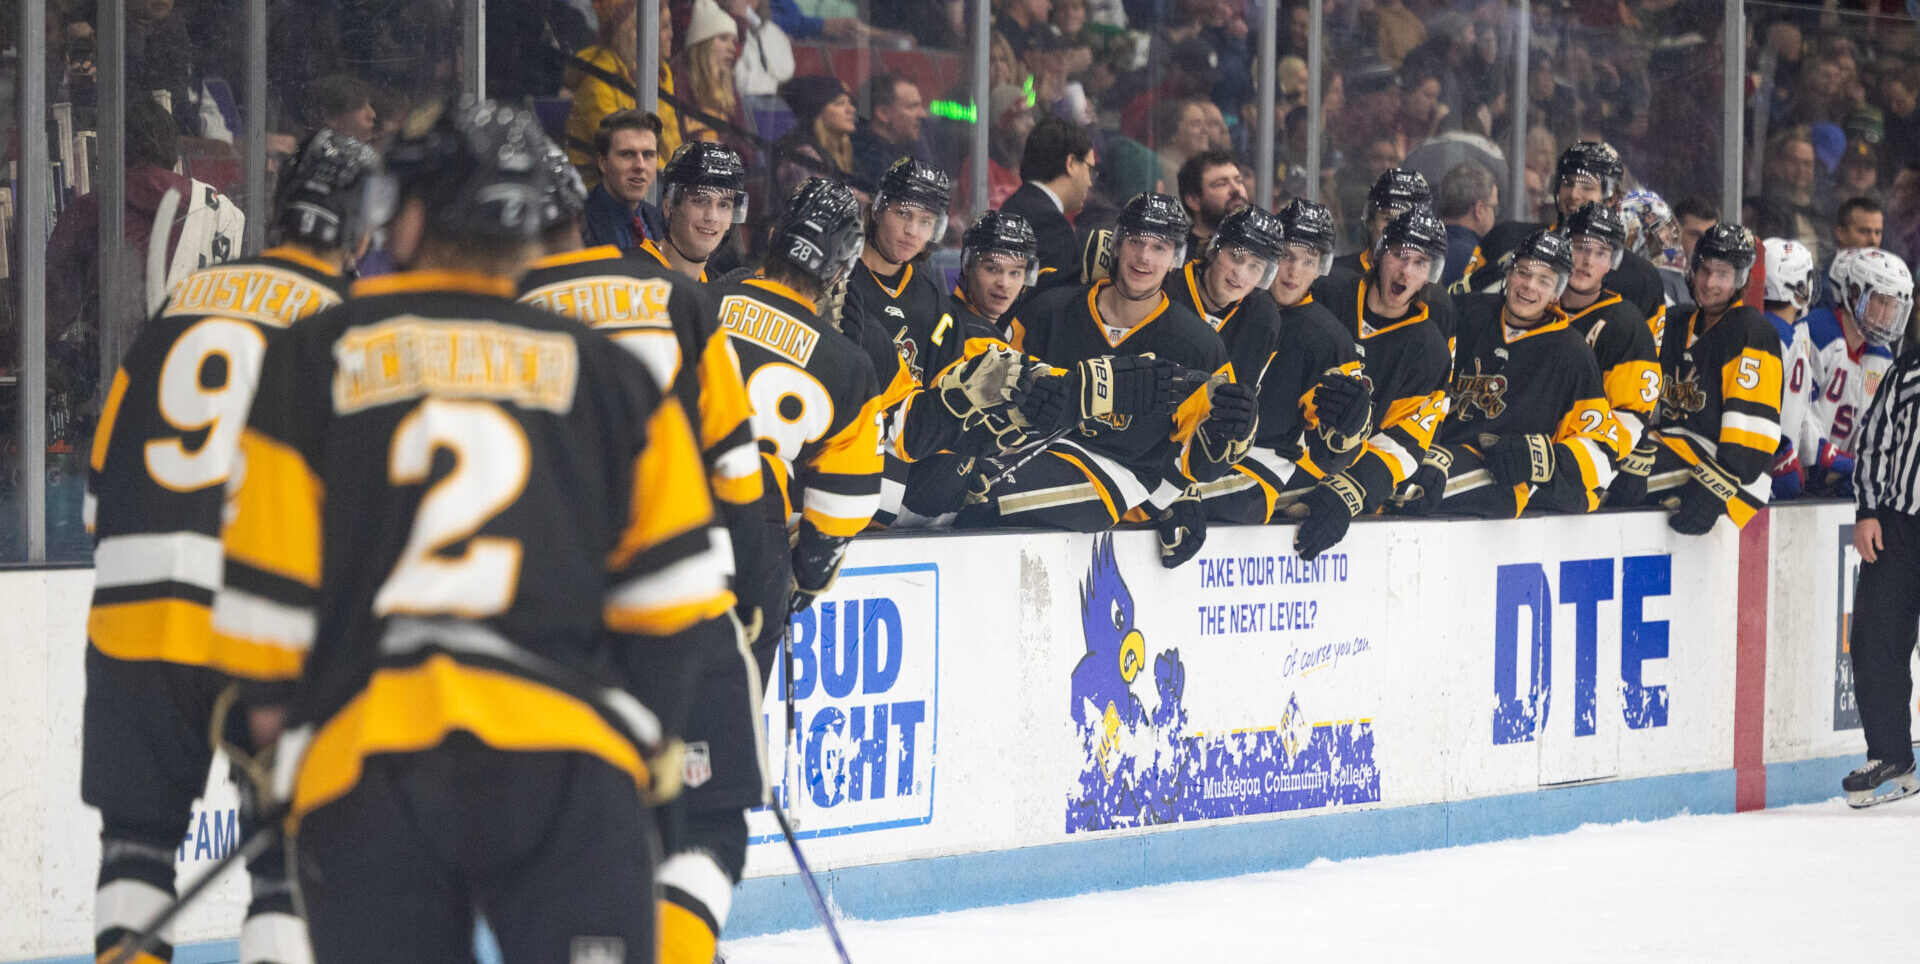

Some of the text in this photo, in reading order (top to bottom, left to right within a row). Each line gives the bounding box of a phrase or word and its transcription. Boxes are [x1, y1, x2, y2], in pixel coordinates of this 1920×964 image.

[789, 243, 811, 261] 28
[721, 299, 814, 361] GRIDIN
[931, 313, 953, 347] C
[1640, 369, 1660, 403] 3
[1737, 356, 1761, 389] 5
[144, 318, 266, 492] 9
[1529, 434, 1544, 478] UER
[372, 397, 532, 619] 2
[1199, 553, 1348, 588] TAKE YOUR TALENT TO
[1198, 600, 1318, 635] THE NEXT LEVEL?
[777, 597, 903, 702] BUD
[1300, 643, 1331, 671] course
[1334, 639, 1351, 669] you
[1352, 637, 1371, 657] can.
[1492, 553, 1672, 745] DTE
[1203, 763, 1373, 802] Muskegon Community College
